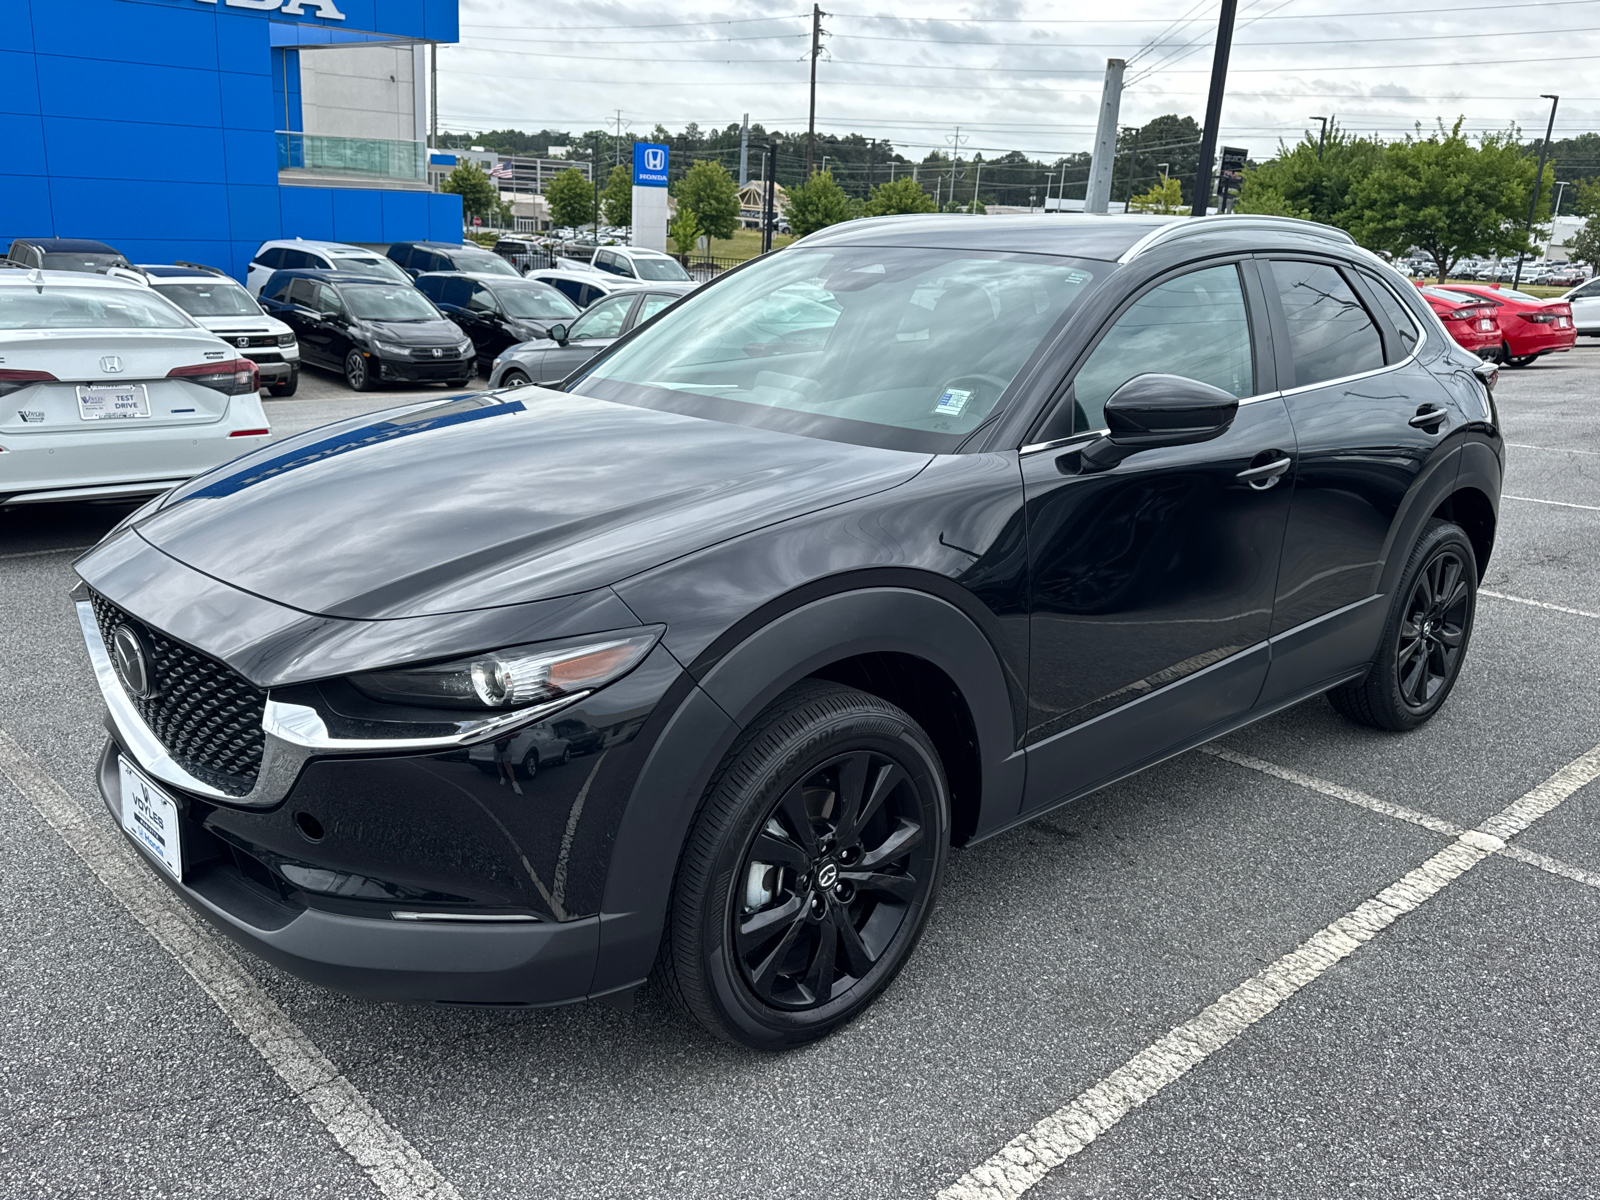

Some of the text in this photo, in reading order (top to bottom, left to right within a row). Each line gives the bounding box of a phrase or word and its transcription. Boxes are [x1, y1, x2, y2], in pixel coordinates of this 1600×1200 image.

[639, 173, 668, 181] HONDA
[132, 792, 164, 830] VOYLES
[144, 832, 164, 857] Honda
